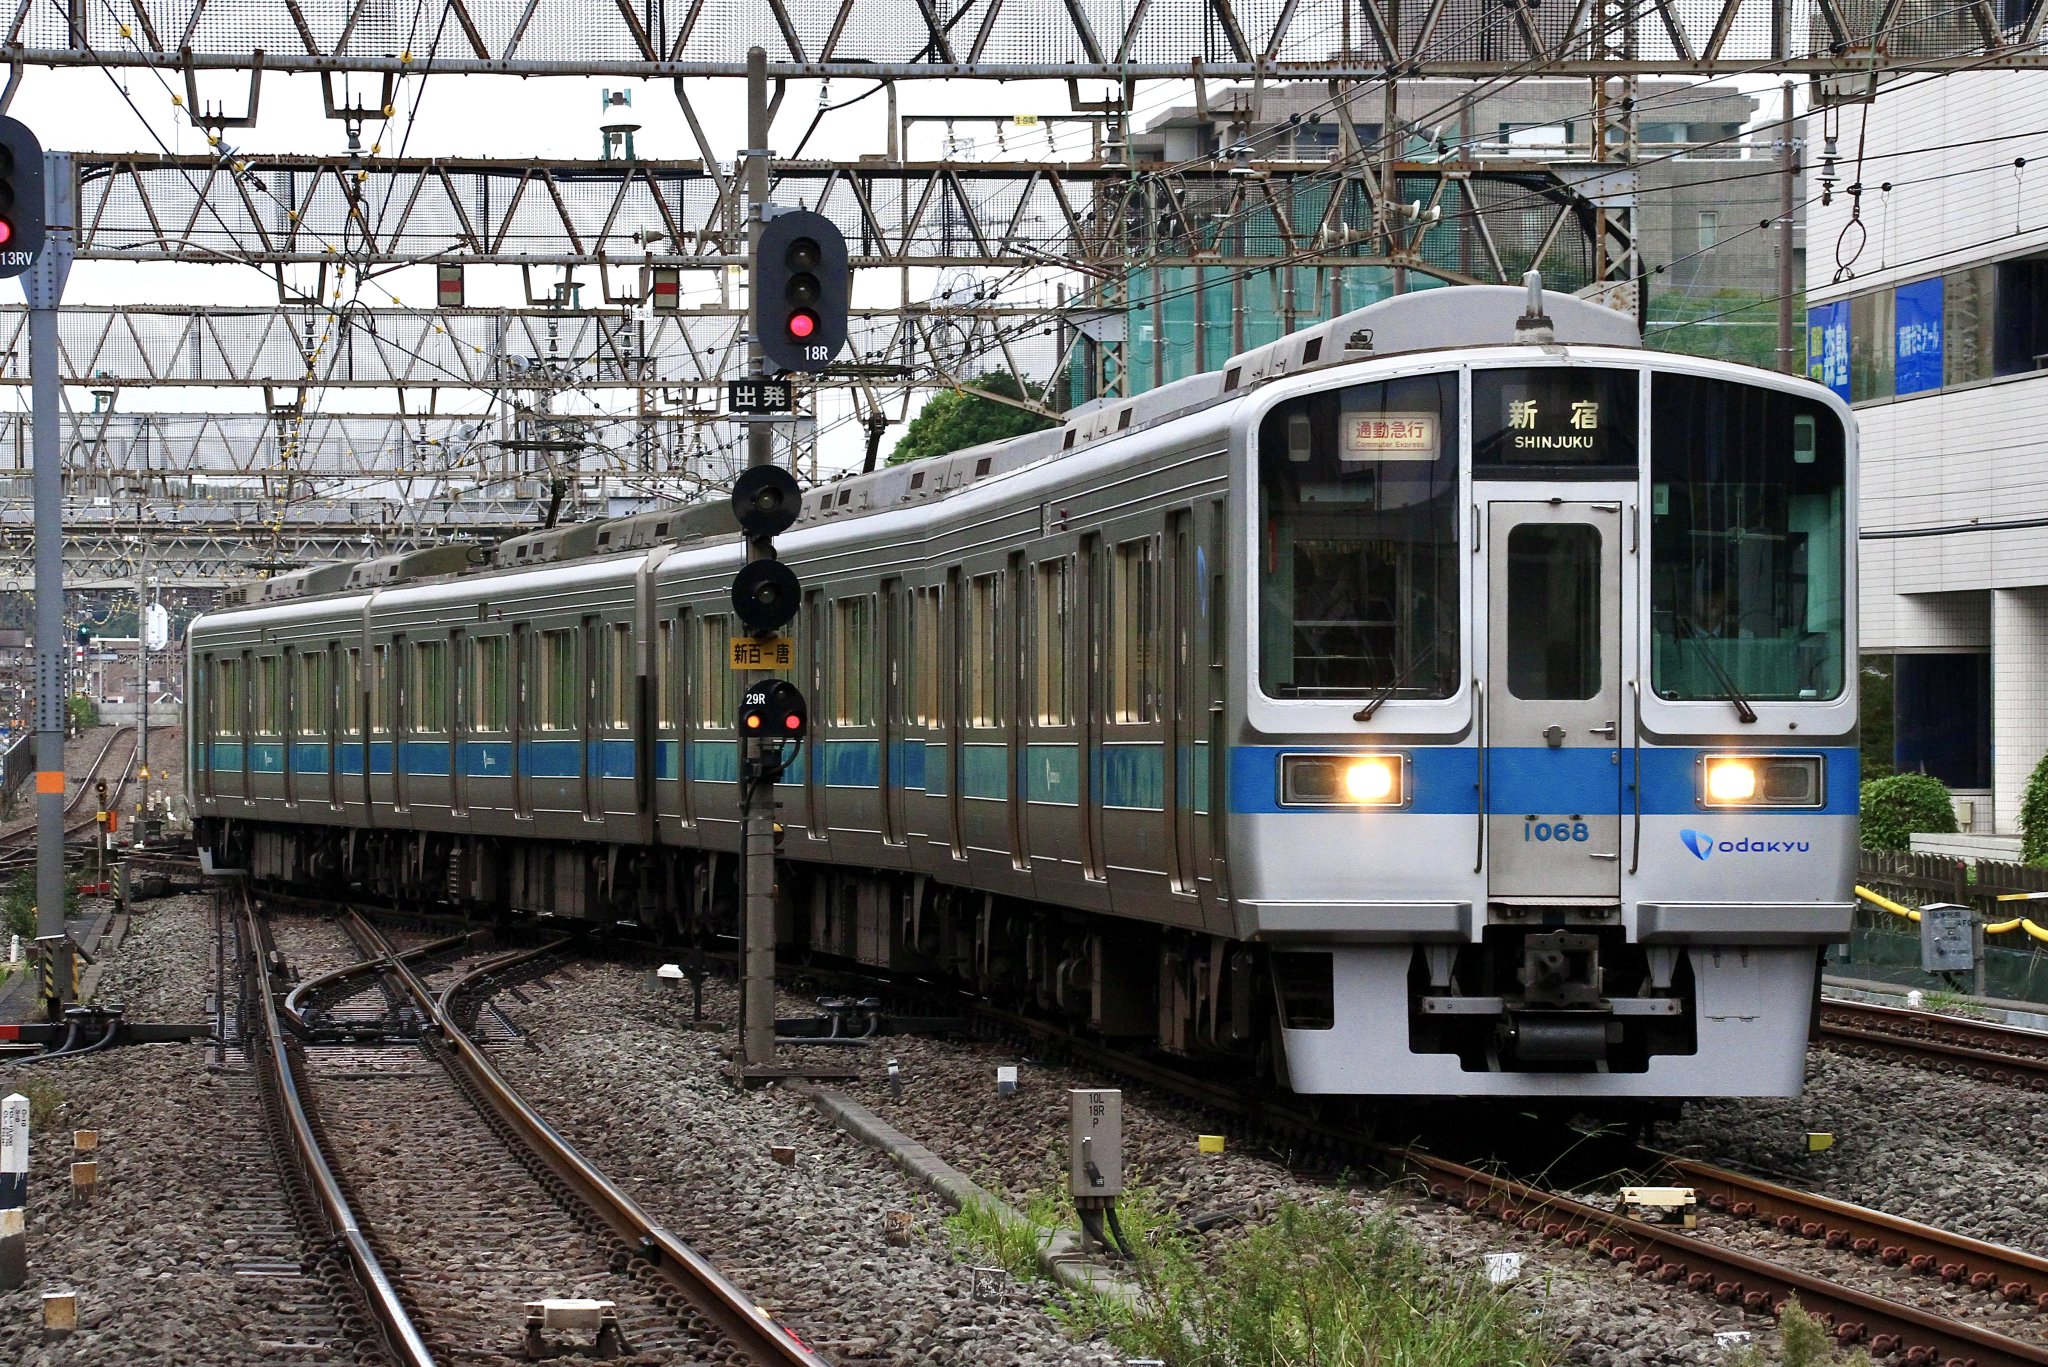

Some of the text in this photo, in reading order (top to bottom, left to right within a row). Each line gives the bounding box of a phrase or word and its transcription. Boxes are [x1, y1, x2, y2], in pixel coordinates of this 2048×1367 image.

[0, 251, 33, 266] 13RV
[804, 345, 829, 361] 18R
[735, 385, 786, 407] 出発
[1507, 399, 1599, 430] 新宿
[1355, 420, 1424, 439] 通勤急行
[1395, 441, 1425, 449] Express
[1514, 435, 1594, 449] SHINJUKU
[746, 693, 766, 705] 29R
[1524, 822, 1589, 842] 1068
[1718, 837, 1810, 853] odakyu
[1088, 1092, 1105, 1104] 10L
[1088, 1105, 1105, 1116] 18R
[1092, 1117, 1099, 1128] P
